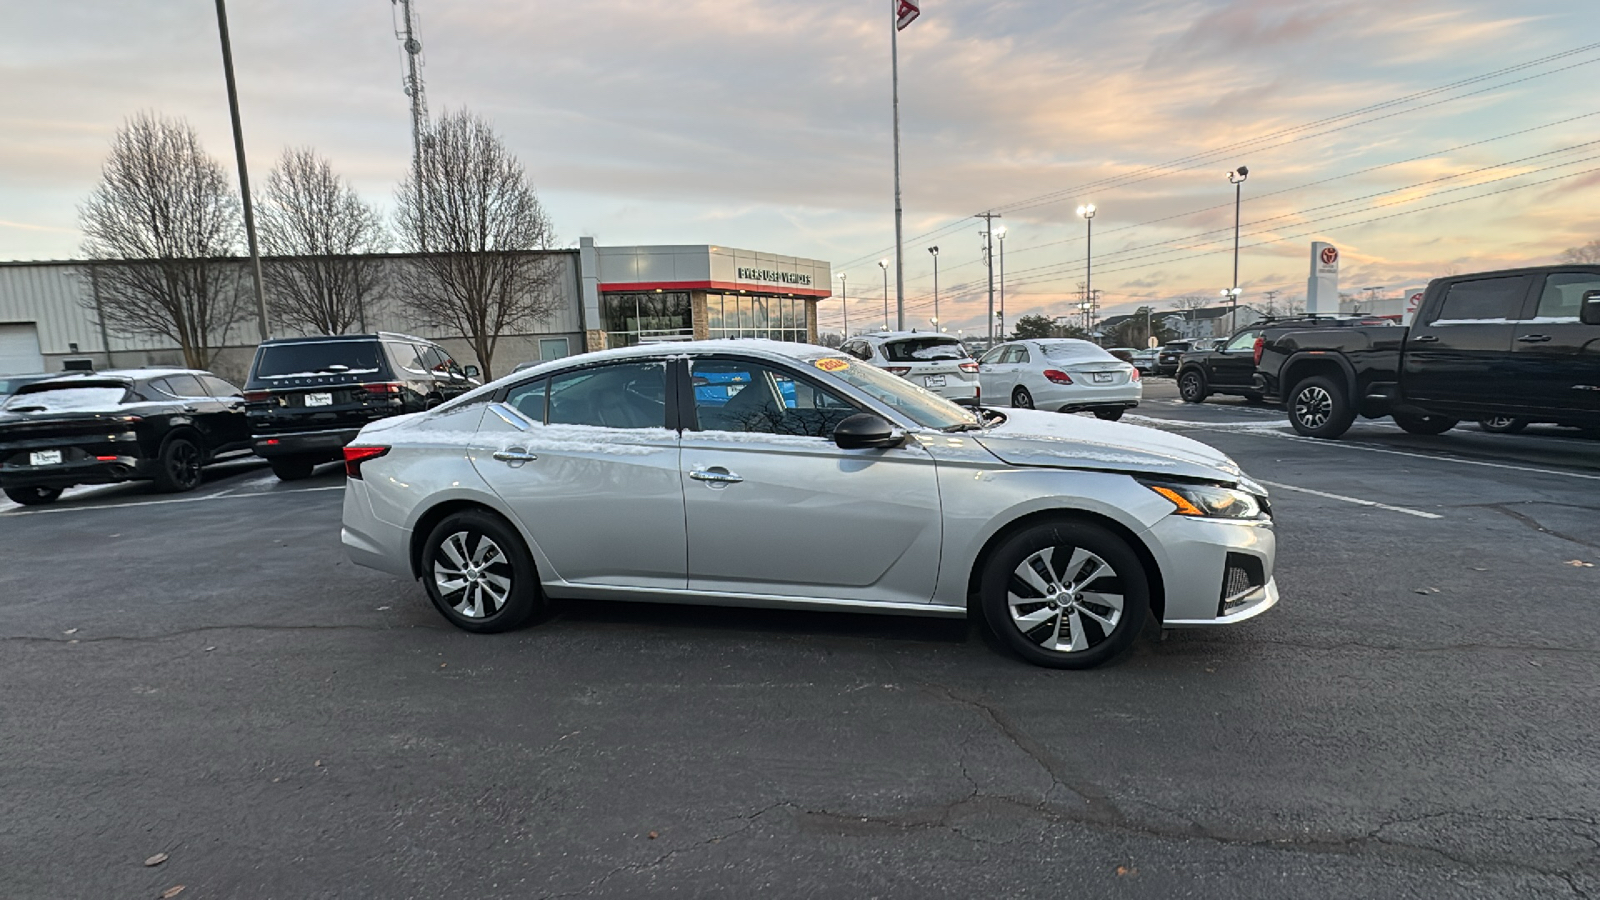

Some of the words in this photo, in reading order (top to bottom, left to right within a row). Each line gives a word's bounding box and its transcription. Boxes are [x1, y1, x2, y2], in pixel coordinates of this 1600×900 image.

[738, 267, 762, 280] BYERS
[781, 272, 811, 285] VEHICLES
[272, 376, 358, 385] WAGONEER
